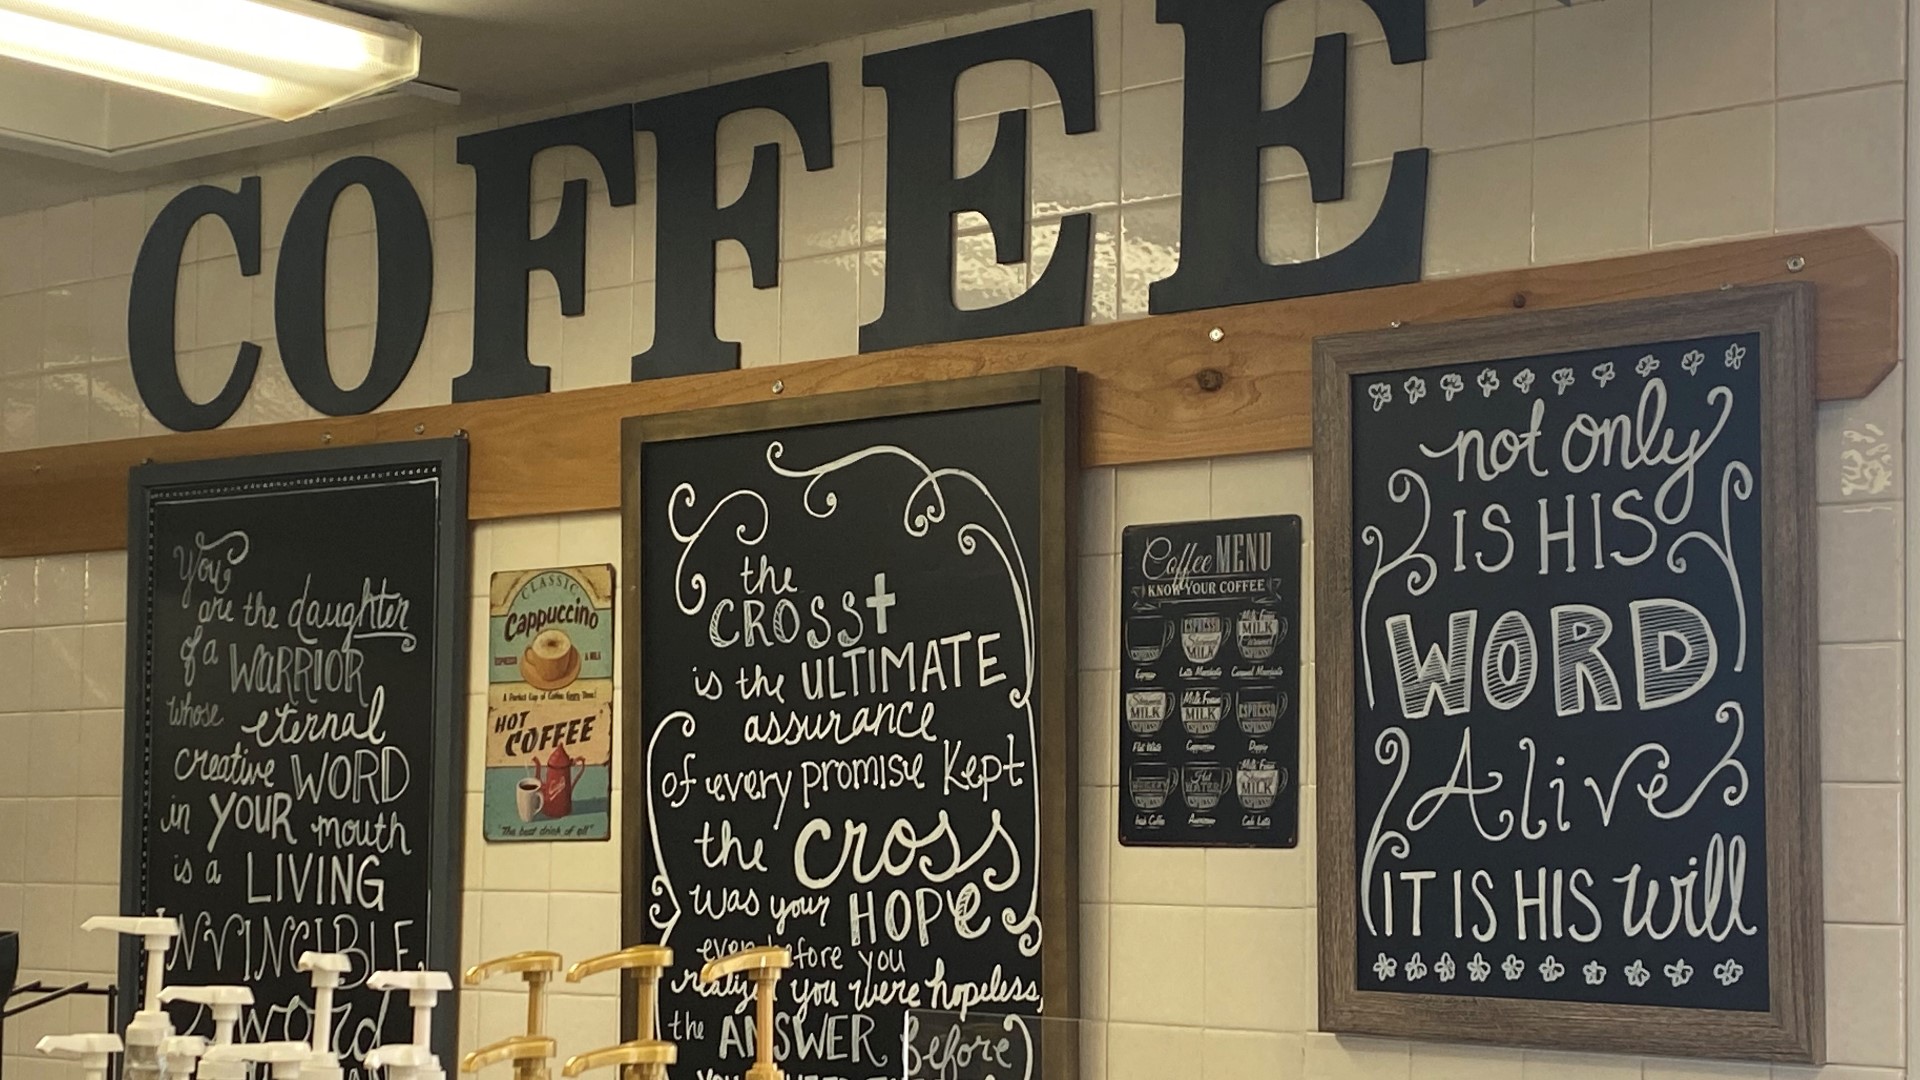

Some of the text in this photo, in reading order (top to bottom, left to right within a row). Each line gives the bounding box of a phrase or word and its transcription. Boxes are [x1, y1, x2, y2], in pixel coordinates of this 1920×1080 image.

[126, 0, 1429, 432] COFFEE
[1419, 376, 1733, 525] not only
[1453, 487, 1658, 575] IS HIS
[173, 530, 249, 608] You
[521, 573, 579, 600] CLASSIC
[739, 554, 797, 595] the
[1142, 532, 1272, 590] Coffee MENU
[1185, 580, 1217, 595] YOUR
[1219, 578, 1266, 594] COFFEE
[198, 573, 415, 656] are the daughter
[504, 597, 599, 642] Cappuccino
[708, 590, 864, 649] CROSS
[1241, 621, 1274, 634] MILK
[180, 625, 203, 687] of
[692, 631, 1006, 703] is the ULTIMATE
[1385, 597, 1718, 719] WORD
[167, 685, 386, 747] whose eternal
[494, 711, 530, 734] HOT
[505, 715, 596, 757] COFFEE
[744, 700, 937, 745] assurance
[1130, 705, 1162, 719] MILK
[1185, 707, 1217, 720] MILK
[175, 742, 410, 804] creative WORD
[662, 752, 696, 807] of
[705, 769, 792, 830] every
[800, 752, 925, 808] promise
[1241, 781, 1273, 795] MILK
[1406, 727, 1700, 841] Alive
[160, 791, 412, 855] in YOUR mouth
[693, 819, 768, 872] the
[173, 851, 385, 911] is a LIVING
[1382, 832, 1758, 943] IT IS HIS will
[770, 895, 831, 935] your
[164, 911, 414, 990] NVINCIBLE
[858, 949, 904, 986] you
[789, 979, 839, 1024] you
[849, 980, 921, 1012] were
[924, 957, 1044, 1022] hopeless,
[668, 1010, 705, 1041] the
